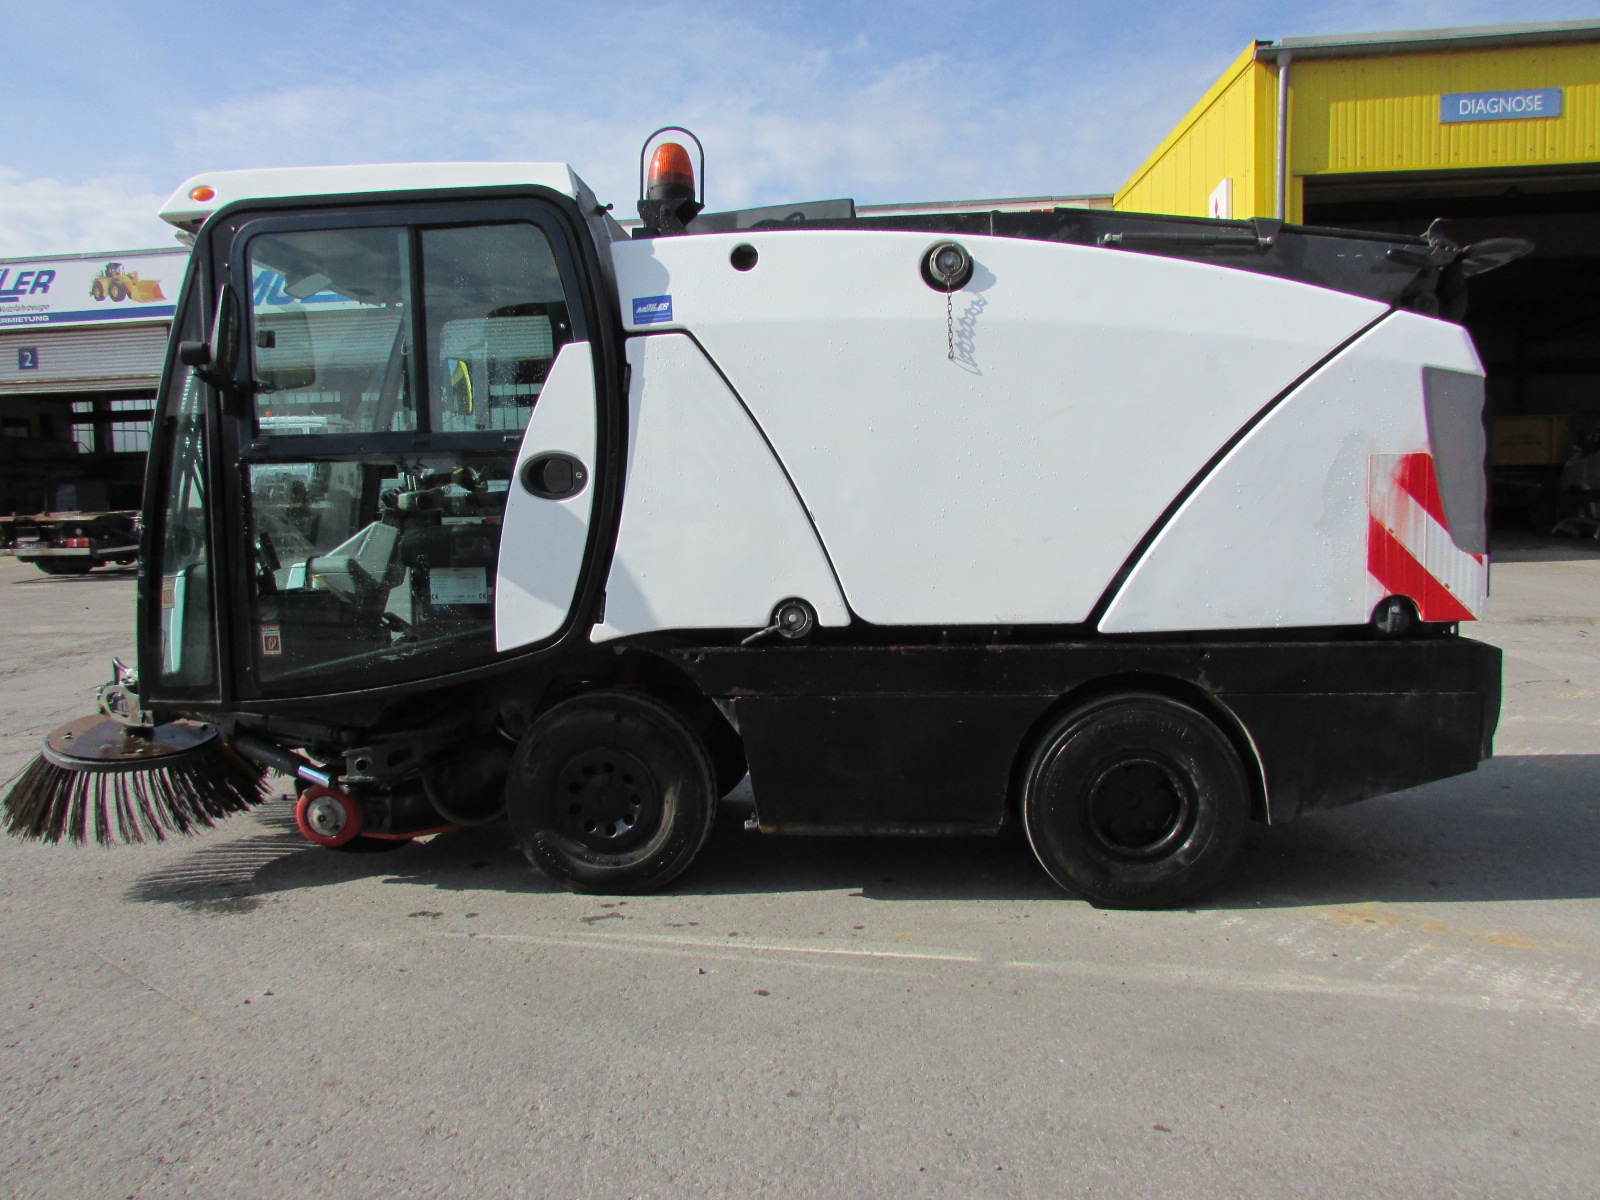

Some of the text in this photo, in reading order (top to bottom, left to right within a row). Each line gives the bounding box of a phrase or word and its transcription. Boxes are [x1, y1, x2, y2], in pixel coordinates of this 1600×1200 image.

[1459, 95, 1543, 115] DIAGNOSE
[0, 268, 56, 296] LER
[0, 315, 49, 323] RMIETUNG
[23, 352, 33, 367] 2
